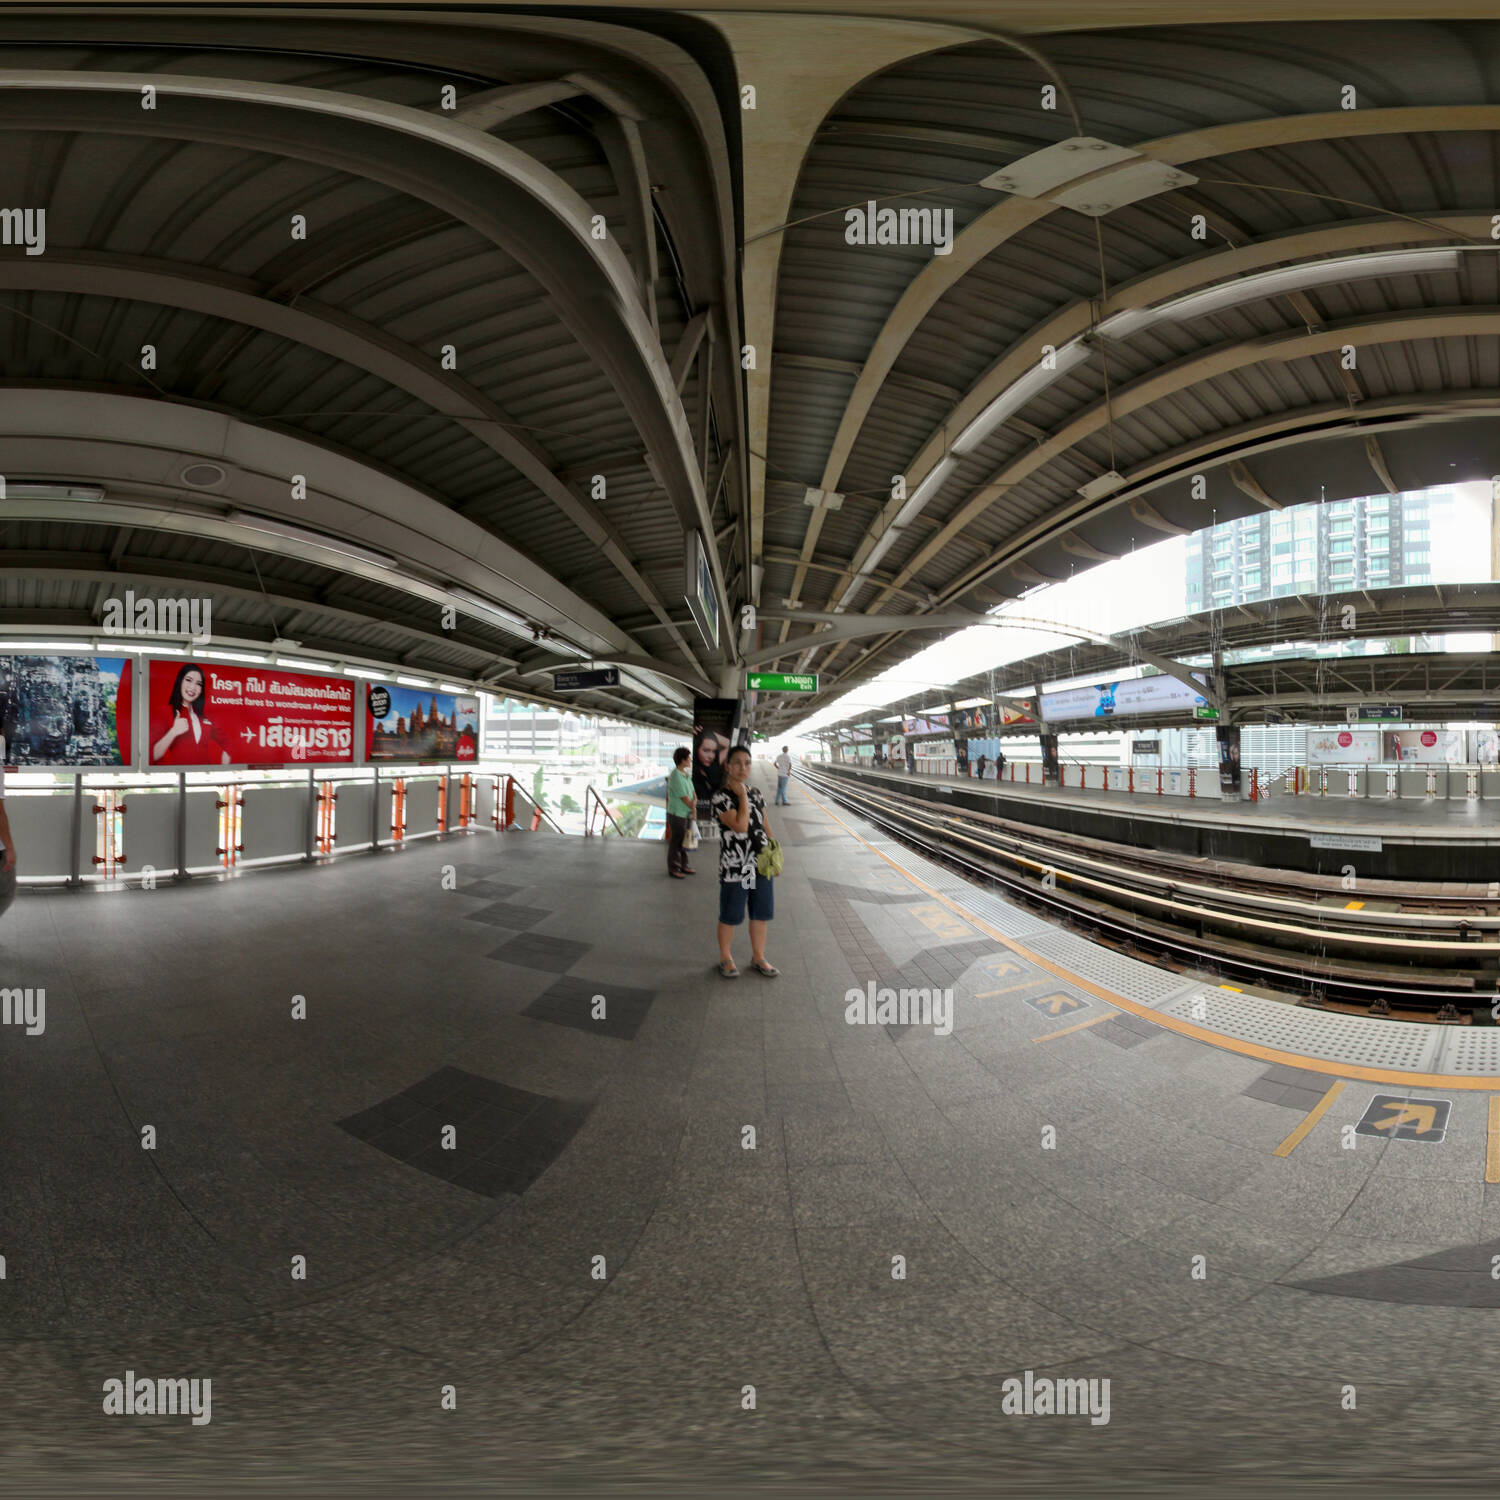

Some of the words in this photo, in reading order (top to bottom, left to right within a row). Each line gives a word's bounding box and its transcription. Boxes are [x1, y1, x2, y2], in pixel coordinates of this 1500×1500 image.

[210, 672, 242, 696] ใครๆ
[783, 675, 813, 686] ทางออก
[210, 695, 244, 706] Lowest
[245, 697, 265, 707] fares
[265, 699, 275, 707] to
[276, 700, 312, 710] wondrous
[313, 703, 338, 713] Angkor
[338, 704, 352, 713] Wat
